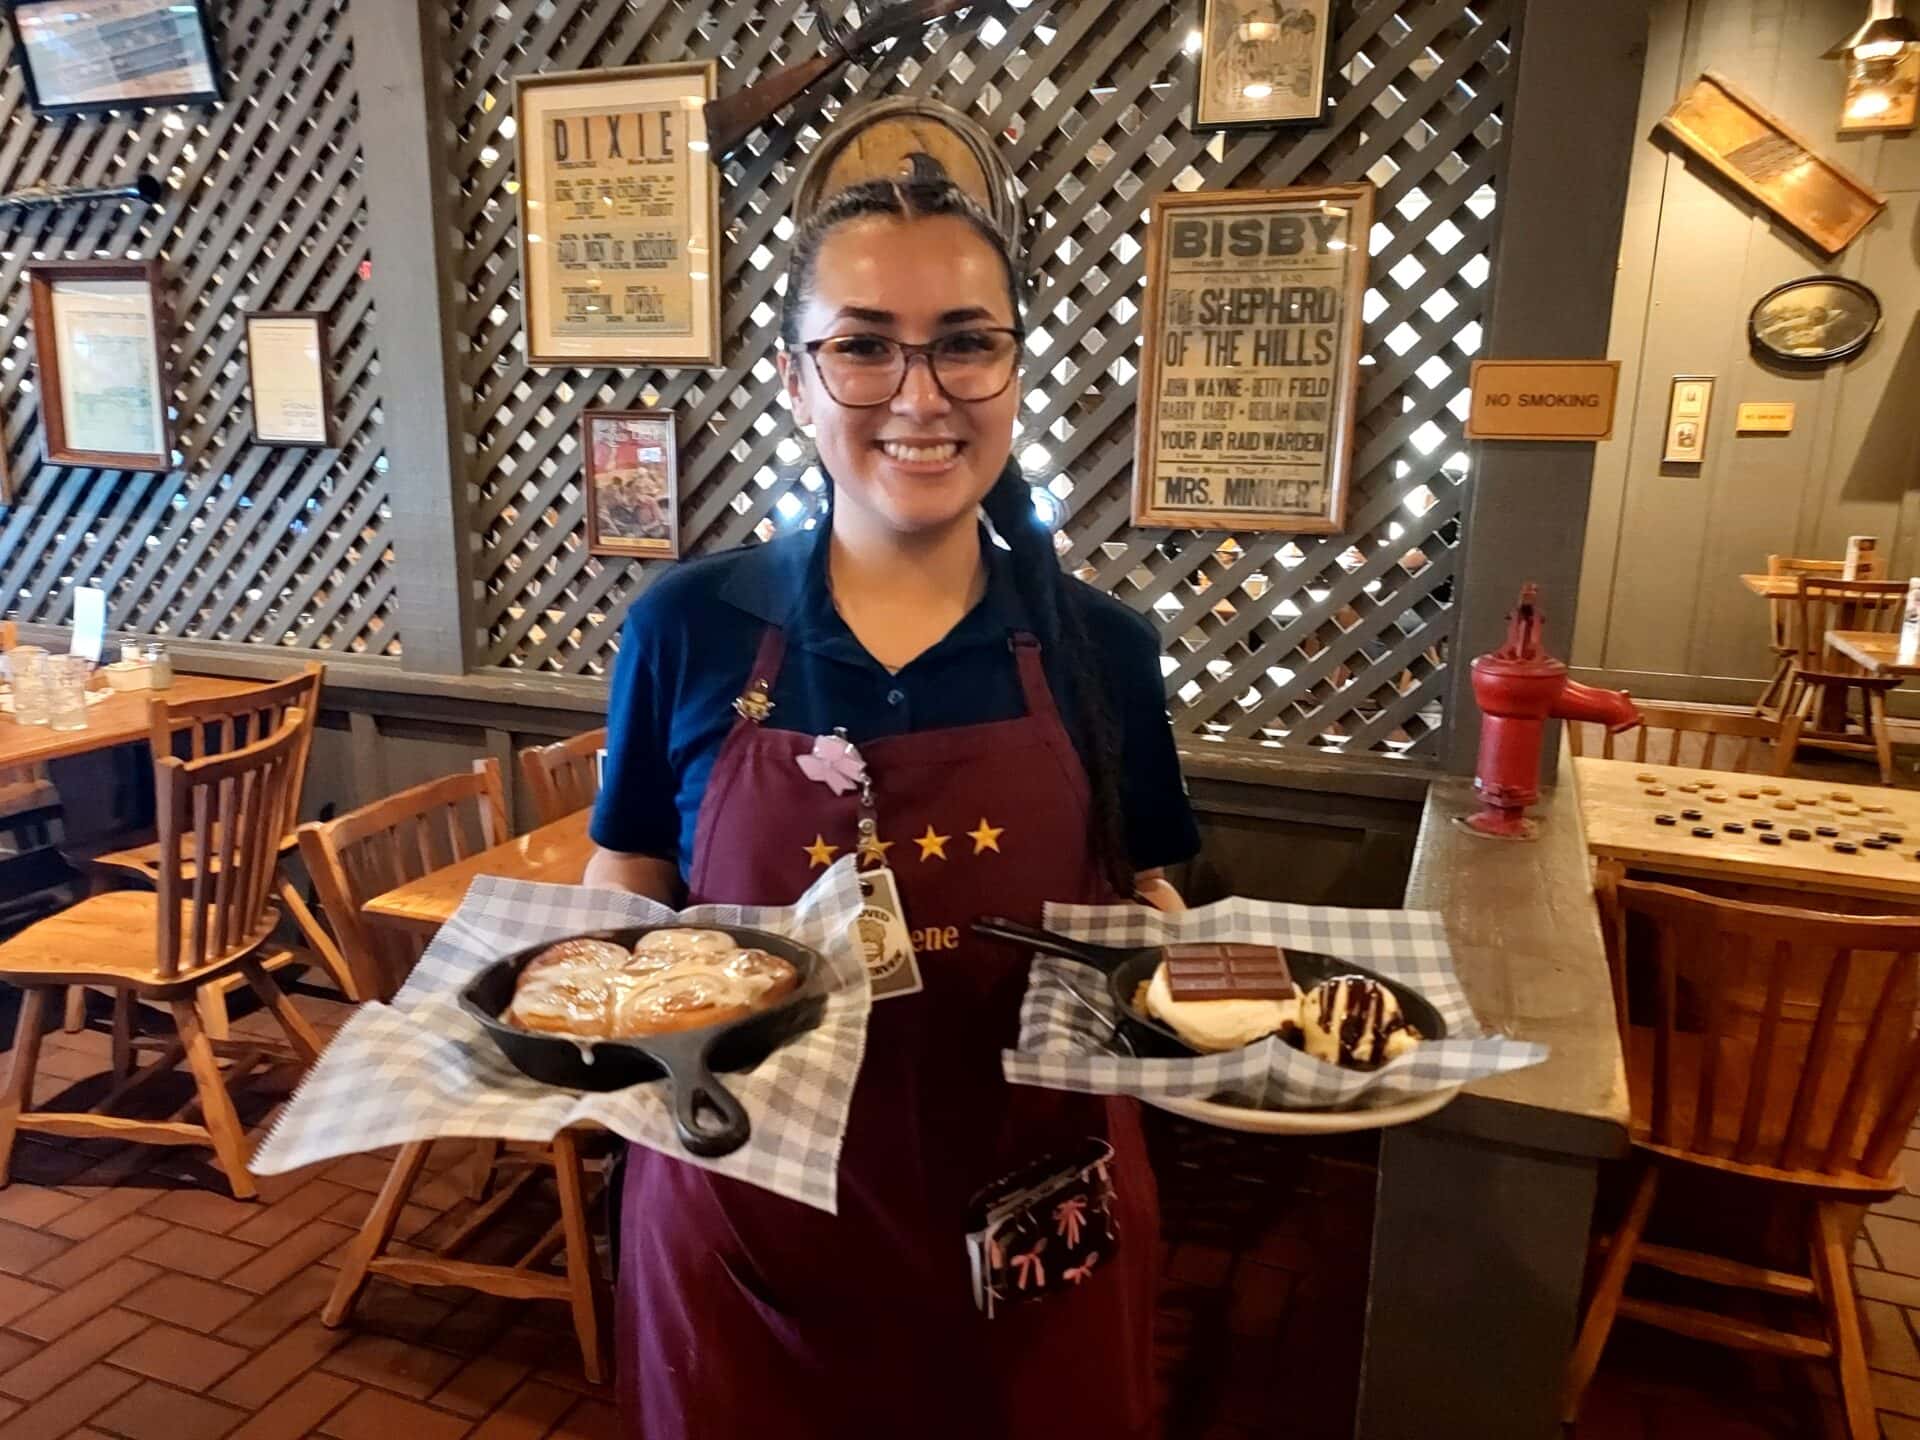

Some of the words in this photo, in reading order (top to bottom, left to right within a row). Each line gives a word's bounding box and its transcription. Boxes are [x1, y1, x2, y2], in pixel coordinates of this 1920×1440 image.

[553, 111, 674, 161] DIXIE
[1172, 216, 1343, 258] BISBY
[1199, 286, 1338, 325] SHEPHERD
[1166, 331, 1192, 367] OF
[1202, 330, 1244, 367] THE
[1253, 329, 1333, 367] HILLS
[1289, 378, 1329, 397] FIELD
[1485, 394, 1510, 407] NO
[1518, 394, 1600, 407] SMOKING
[1161, 431, 1196, 449] YOUR
[1201, 431, 1223, 450] AIR
[1227, 431, 1260, 450] RAID
[1263, 432, 1324, 451] WARDEN
